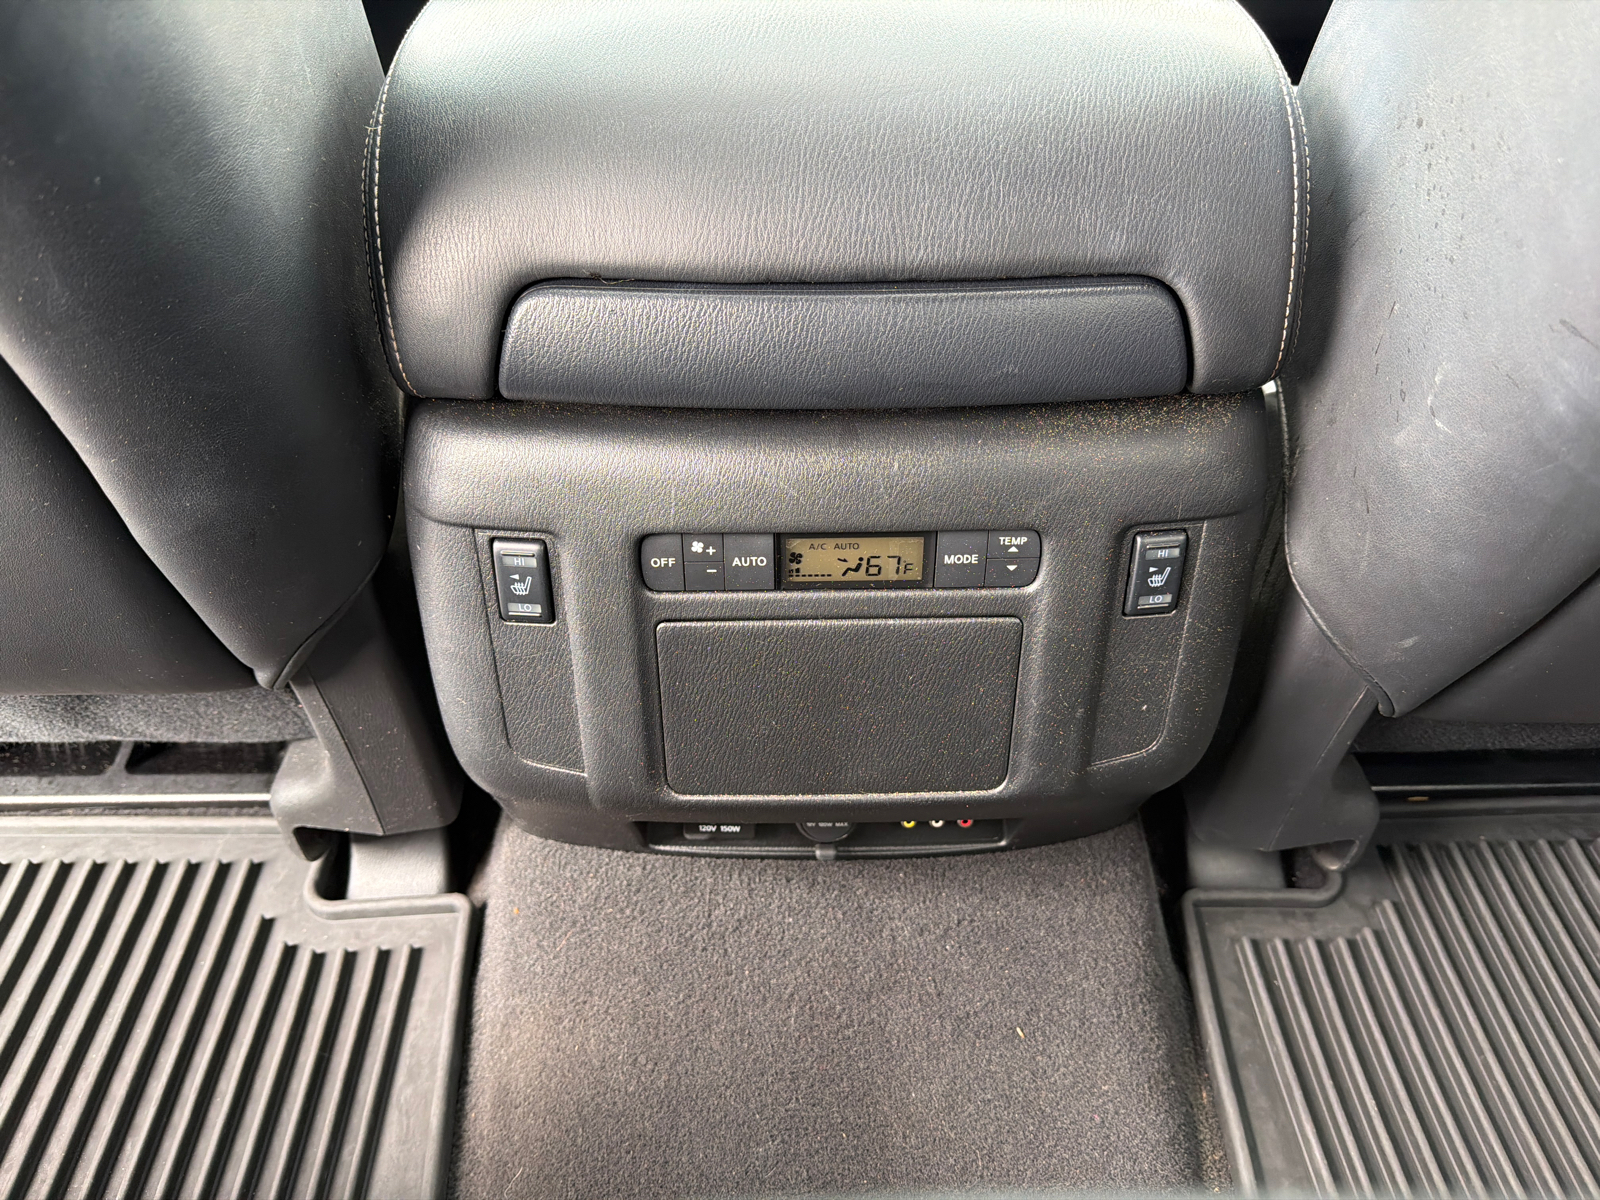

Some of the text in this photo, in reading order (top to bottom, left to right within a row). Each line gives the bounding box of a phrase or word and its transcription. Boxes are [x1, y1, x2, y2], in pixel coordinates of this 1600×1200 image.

[999, 536, 1028, 546] TEMP
[808, 542, 860, 551] A/C AUTO
[1157, 549, 1169, 558] HI
[513, 557, 525, 566] HI
[650, 557, 676, 568] OFF
[732, 556, 767, 567] AUTO
[943, 554, 979, 565] MODE
[1149, 595, 1163, 604] LO
[518, 603, 532, 612] LO
[698, 824, 741, 833] 120V 150W
